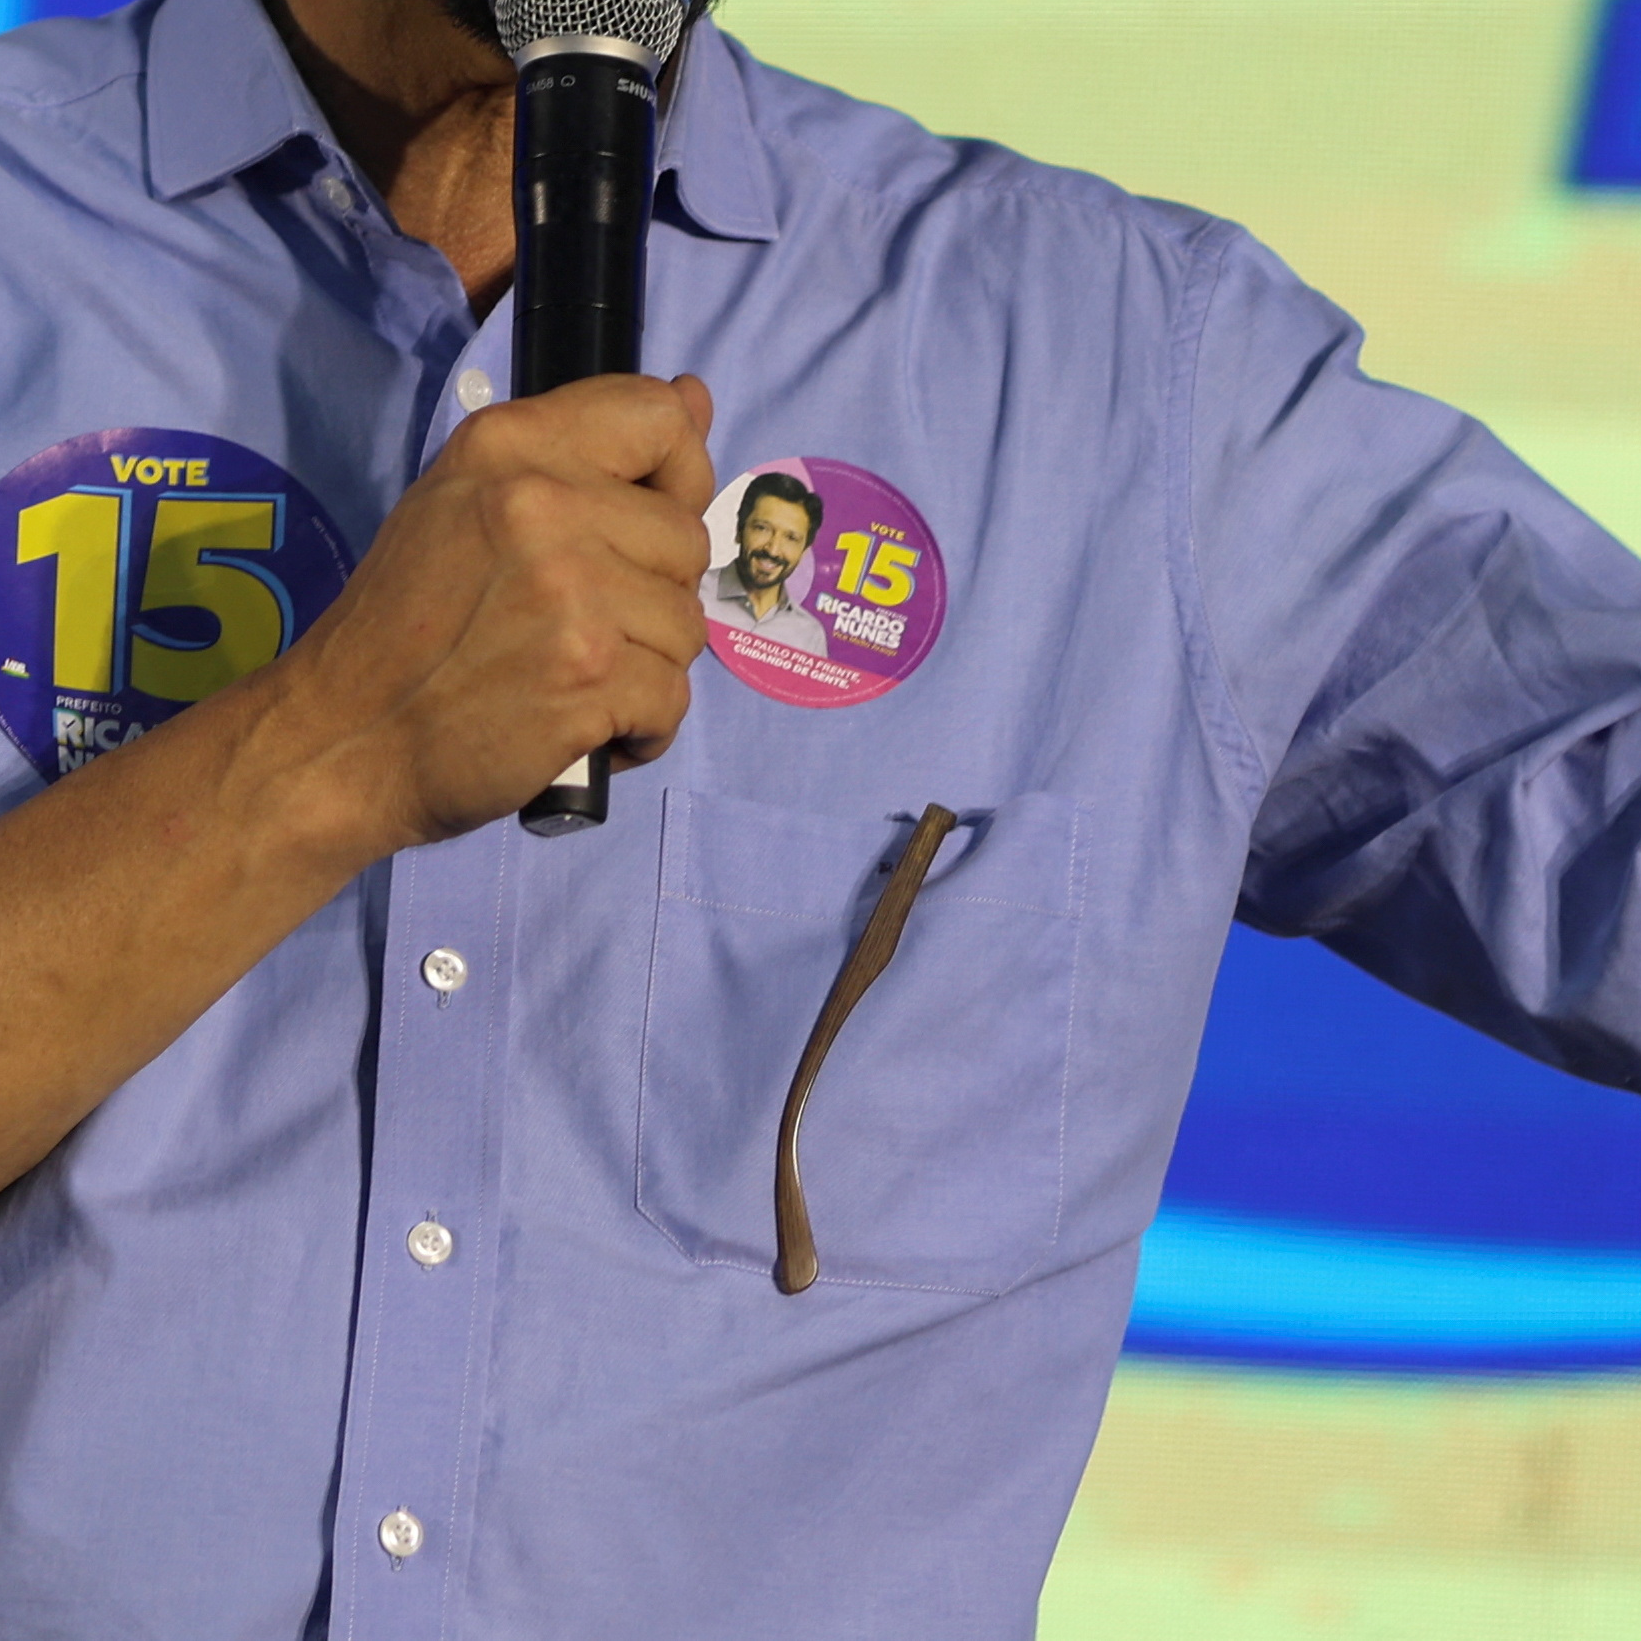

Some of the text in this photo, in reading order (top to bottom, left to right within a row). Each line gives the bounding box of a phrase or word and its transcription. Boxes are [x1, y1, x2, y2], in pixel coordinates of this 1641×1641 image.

[616, 77, 656, 108] SHU
[110, 455, 210, 487] VOTE
[870, 521, 907, 541] VOTE
[835, 530, 921, 607] 15
[16, 485, 294, 702] 15
[816, 592, 905, 636] RICARDO
[833, 615, 901, 649] NUNES
[733, 643, 792, 670] CUIDANDO
[792, 662, 810, 677] DE
[753, 639, 791, 658] PAULO
[791, 651, 814, 667] PRA
[56, 694, 122, 715] PREFEITO
[53, 707, 159, 751] RICA
